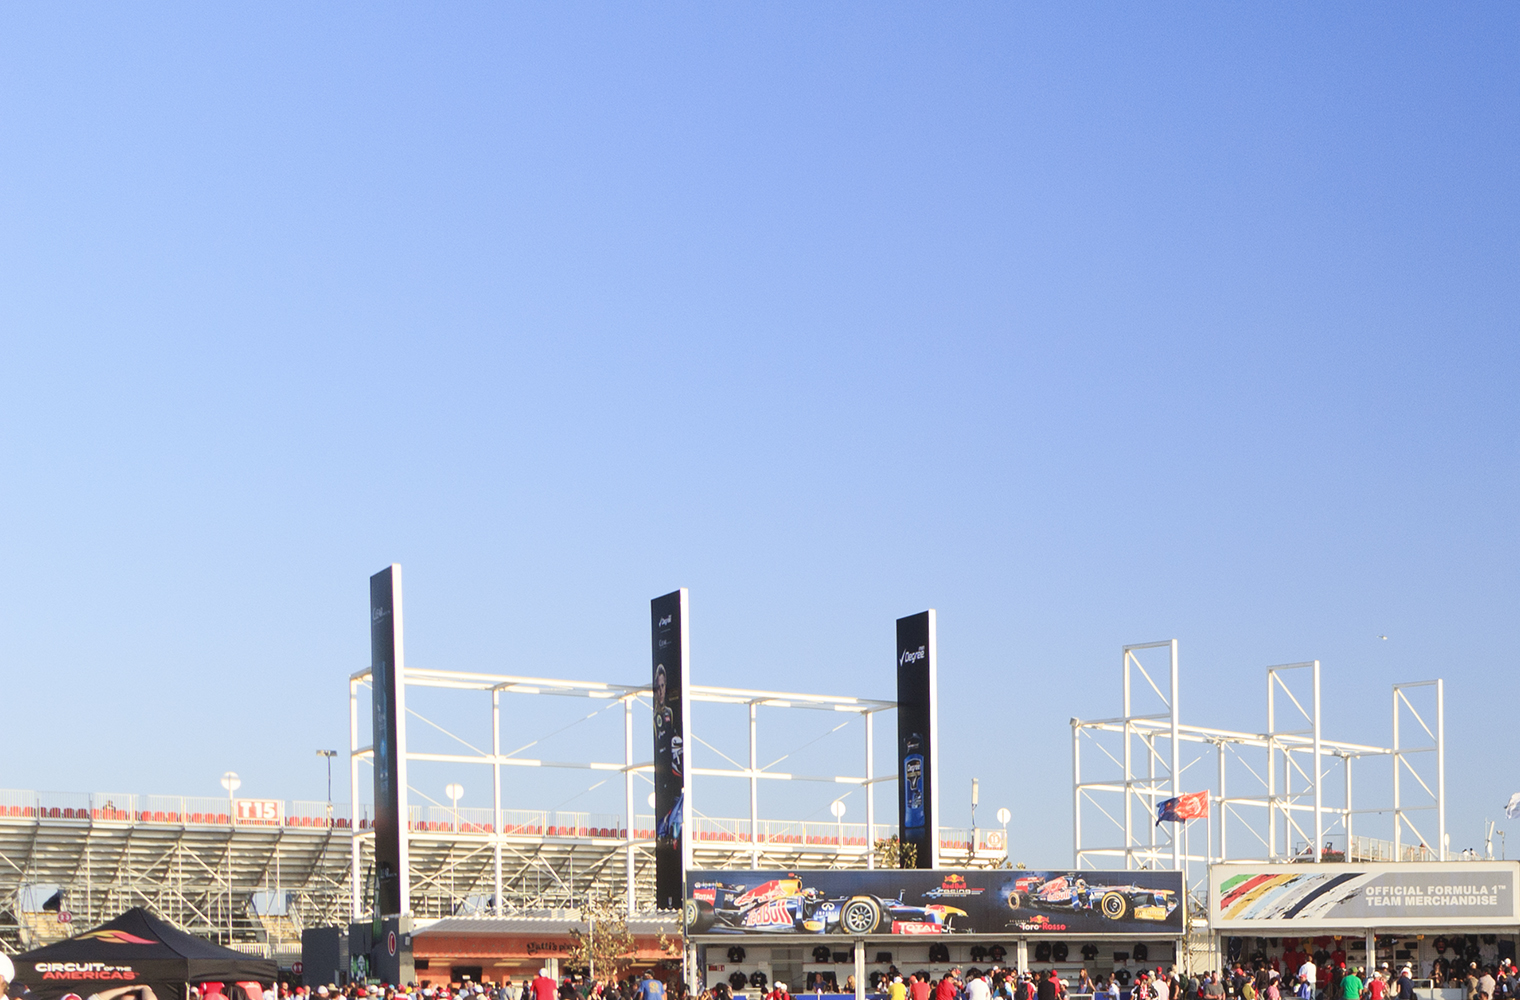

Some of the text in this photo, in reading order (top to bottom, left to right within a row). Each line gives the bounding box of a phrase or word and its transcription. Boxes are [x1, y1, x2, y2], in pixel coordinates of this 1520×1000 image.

[904, 650, 925, 664] Degree
[240, 801, 276, 819] T15
[1365, 886, 1424, 896] OFFICIAL
[1427, 885, 1488, 895] FORMULA
[694, 893, 715, 901] TOTAL
[1366, 895, 1498, 906] TEAM MERCHANDISE
[898, 922, 940, 933] TOTAL
[1021, 922, 1067, 931] Toro Rosso
[35, 962, 106, 972] CIRCUIT
[42, 971, 136, 980] AMERICAS
